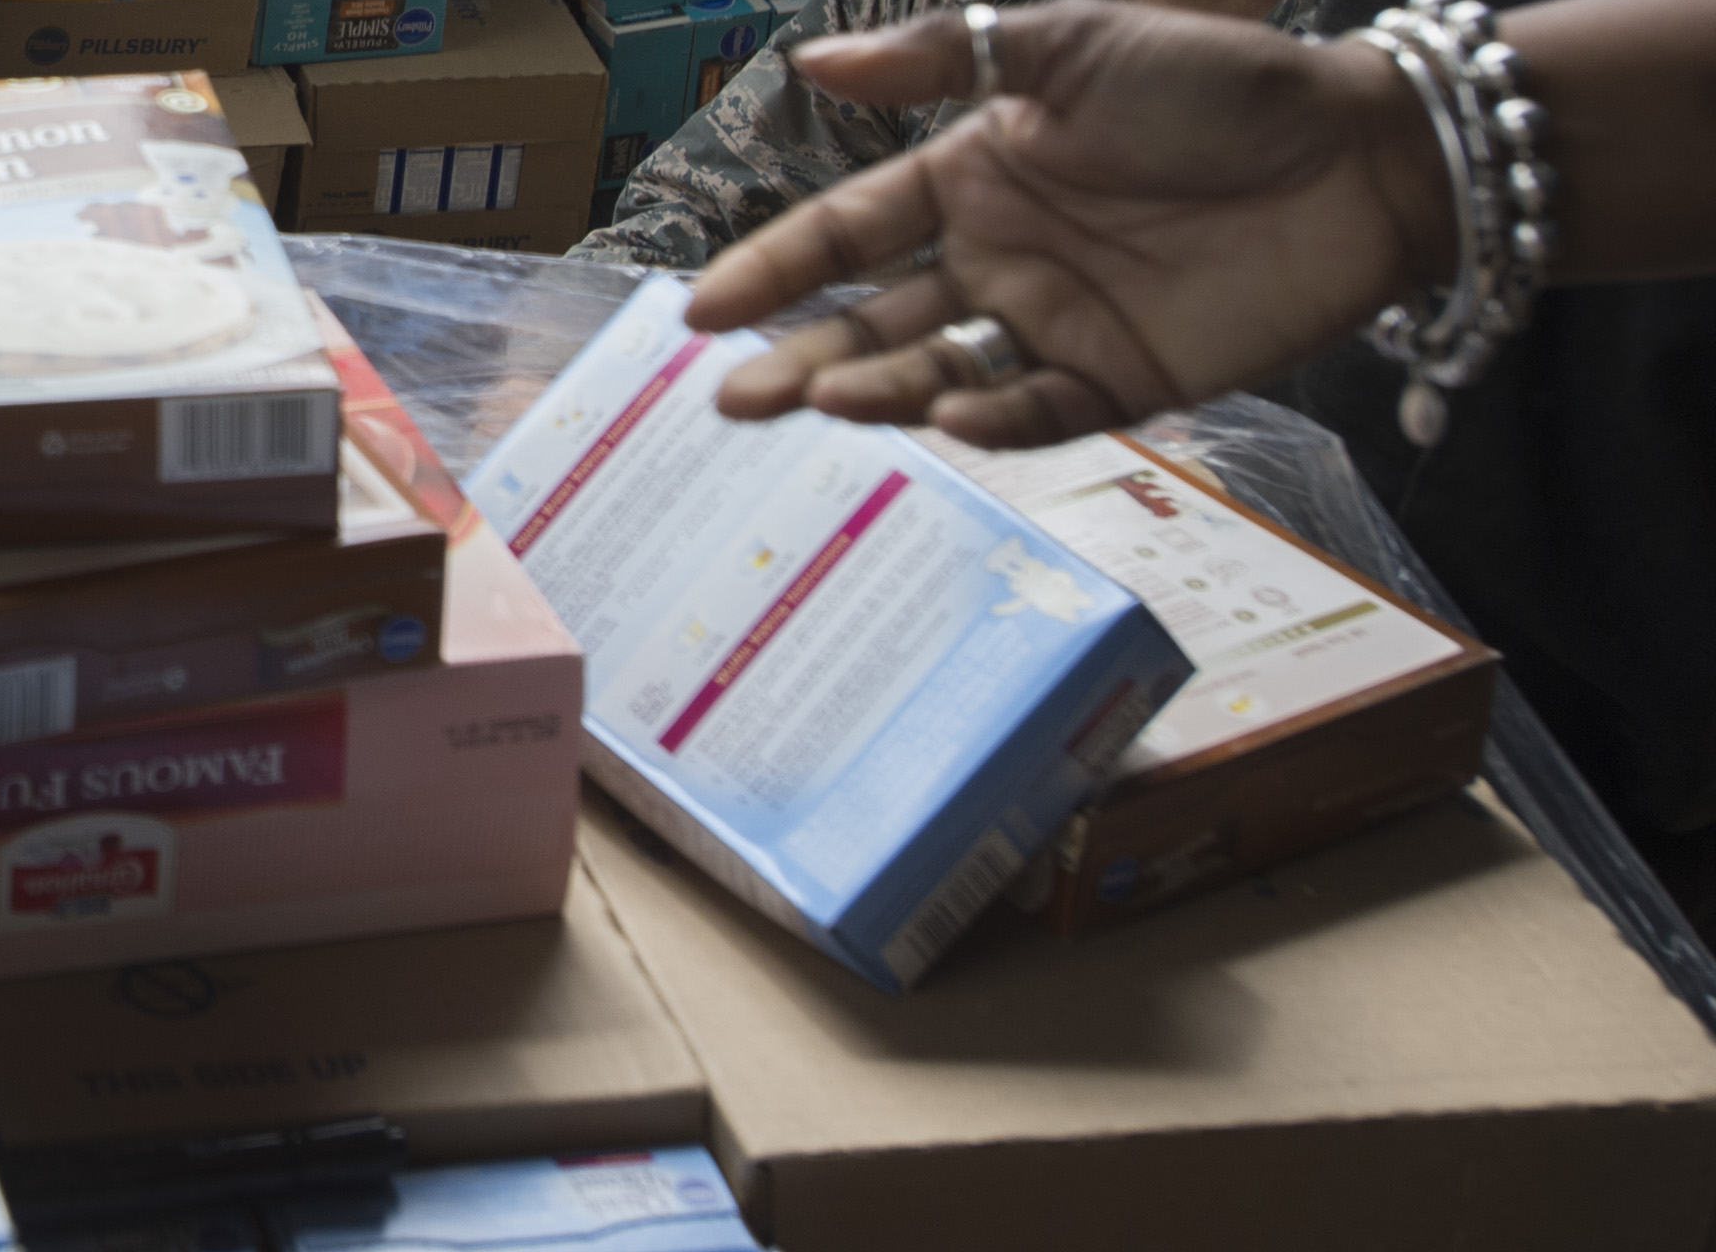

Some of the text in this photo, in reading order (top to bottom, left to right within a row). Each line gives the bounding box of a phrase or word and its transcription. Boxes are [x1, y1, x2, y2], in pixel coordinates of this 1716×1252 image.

[338, 18, 390, 39] SIMPLE
[394, 19, 433, 34] Pillsbury
[79, 37, 201, 56] PILLSBURY
[338, 38, 382, 48] PURELY
[81, 741, 287, 801] FAMOUS
[307, 1050, 369, 1082] UP
